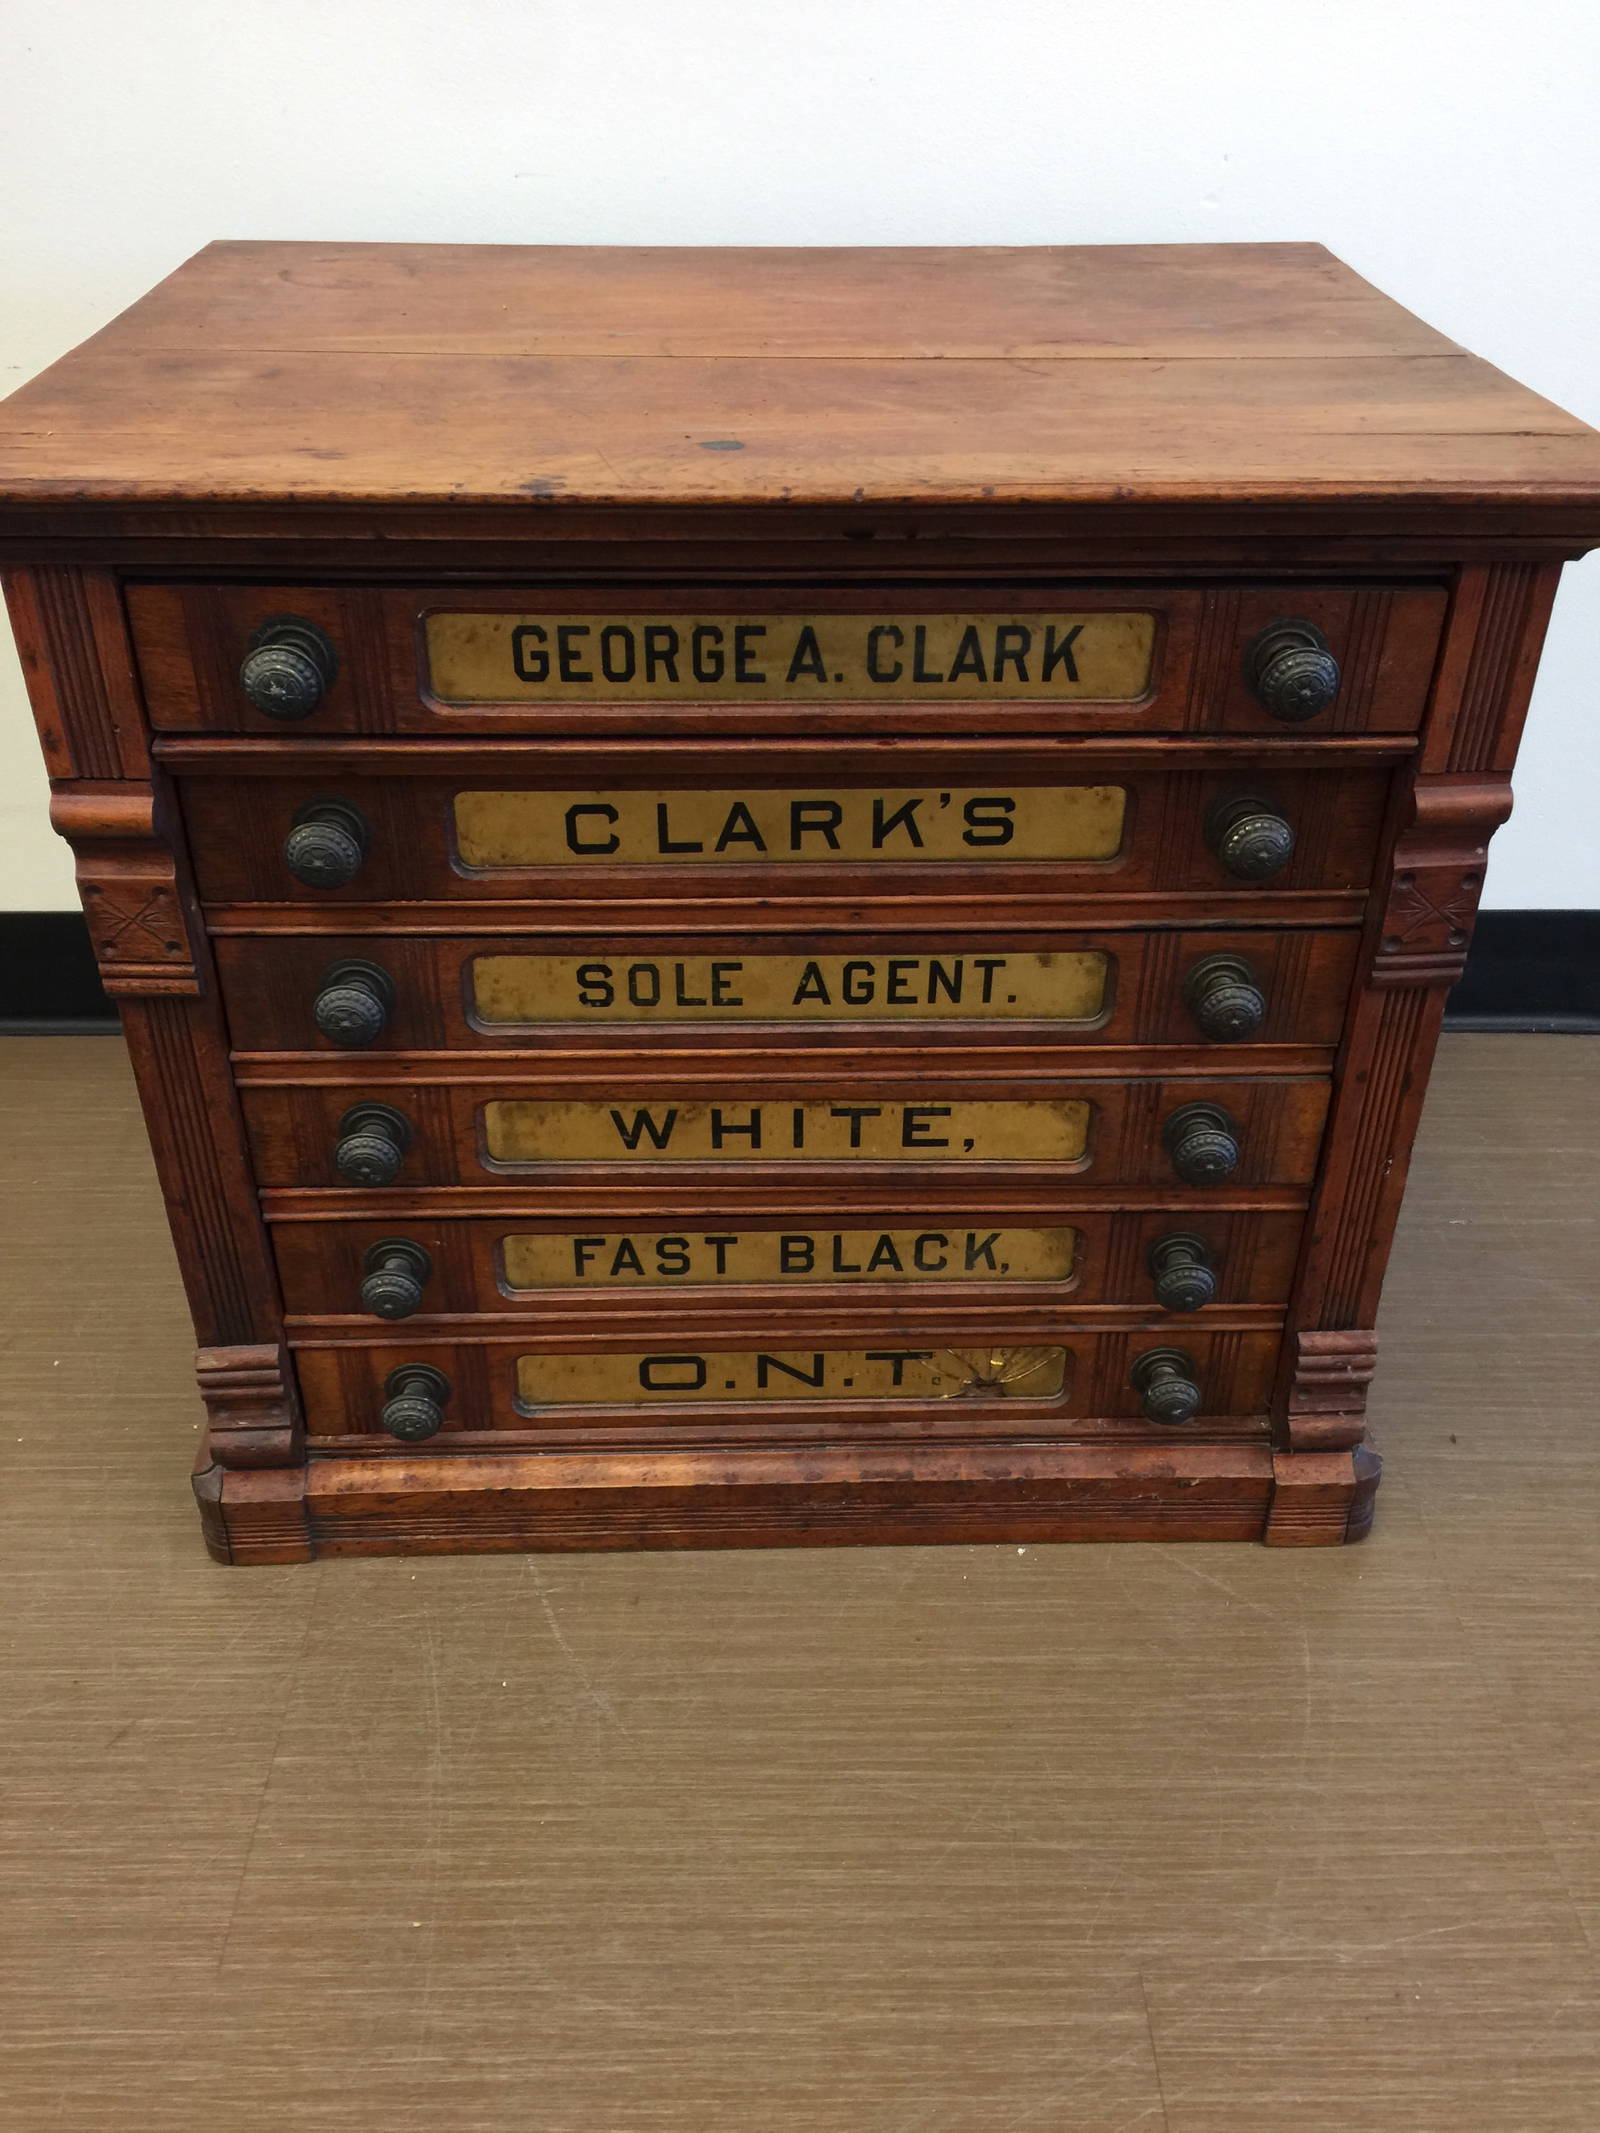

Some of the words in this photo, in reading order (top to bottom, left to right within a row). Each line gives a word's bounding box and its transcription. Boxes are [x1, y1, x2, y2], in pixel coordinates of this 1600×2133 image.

[511, 624, 766, 683] GEORGE
[786, 624, 843, 683] A.
[866, 624, 1085, 683] CLARK
[564, 792, 1017, 855] CLARK'S
[575, 961, 744, 1008] SOLE
[792, 959, 1017, 1006] AGENT.
[610, 1106, 976, 1153] WHITE,
[573, 1237, 739, 1277] FAST
[780, 1232, 1010, 1275] BLACK,
